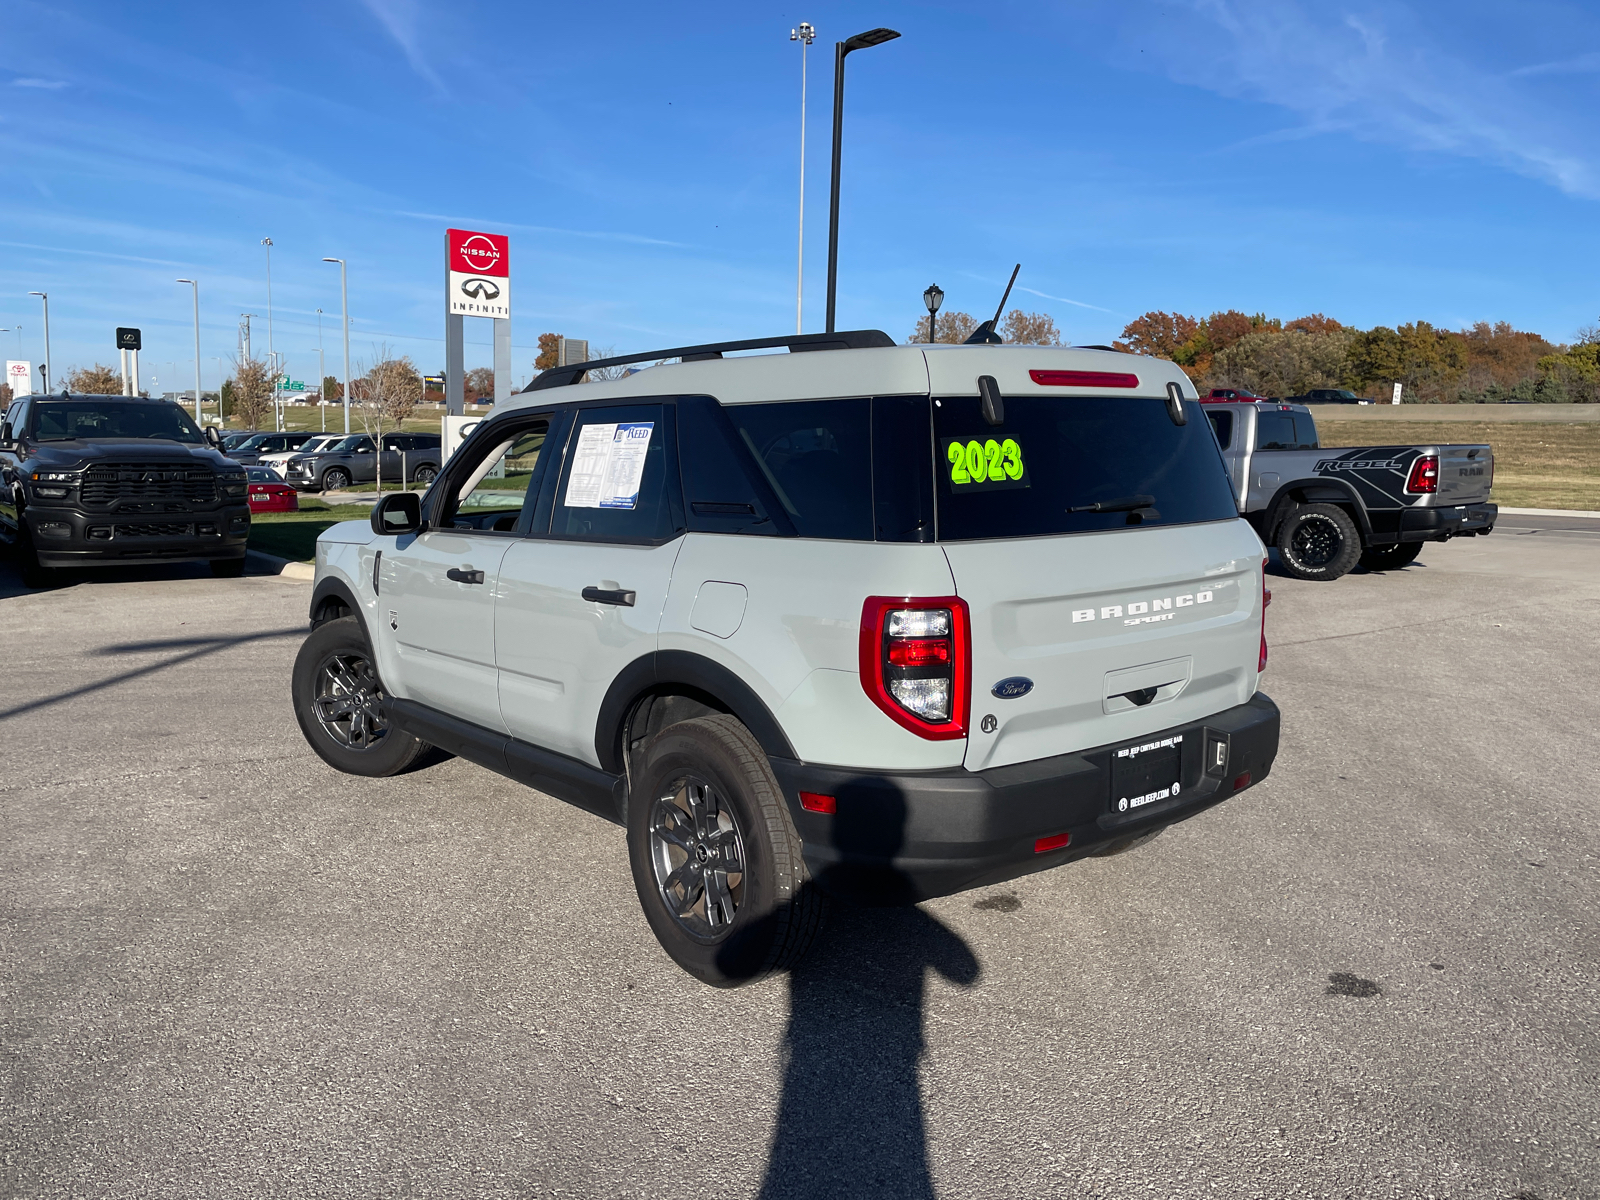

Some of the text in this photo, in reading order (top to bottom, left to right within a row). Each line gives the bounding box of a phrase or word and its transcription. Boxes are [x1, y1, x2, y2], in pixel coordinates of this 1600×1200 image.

[460, 247, 500, 258] NISSAN
[453, 302, 508, 315] INFINITI
[627, 428, 649, 439] REED
[947, 438, 1024, 485] 2023
[1312, 459, 1403, 472] REBEL
[1459, 468, 1484, 477] RAM
[1072, 591, 1213, 624] BRONCO
[1002, 683, 1026, 695] Ford
[1118, 735, 1182, 757] REED JEEP CHRYSLER DODGE RAM
[1130, 788, 1169, 808] REEDJEEP.COM
